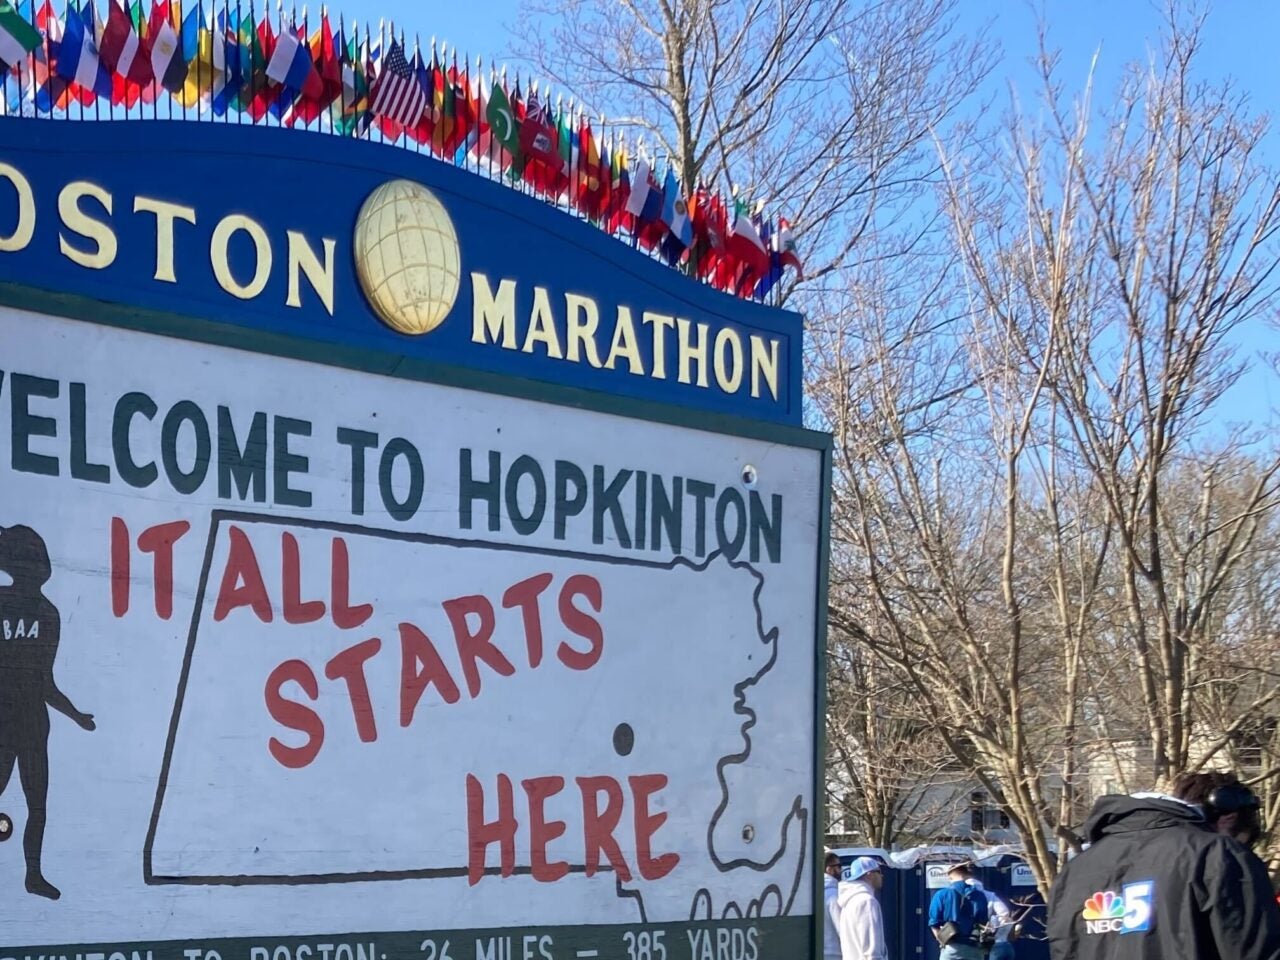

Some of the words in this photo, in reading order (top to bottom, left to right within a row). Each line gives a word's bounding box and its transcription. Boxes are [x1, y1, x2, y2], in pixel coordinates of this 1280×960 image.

[471, 272, 780, 400] MARATHON
[337, 427, 425, 522] TO
[458, 446, 784, 564] HOPKINTON
[3, 619, 39, 640] BAA
[110, 517, 191, 619] IT
[213, 525, 373, 630] ALL
[263, 571, 603, 769] STARTS
[466, 772, 681, 886] HERE
[1086, 919, 1123, 935] NBC
[1123, 884, 1151, 929] 5
